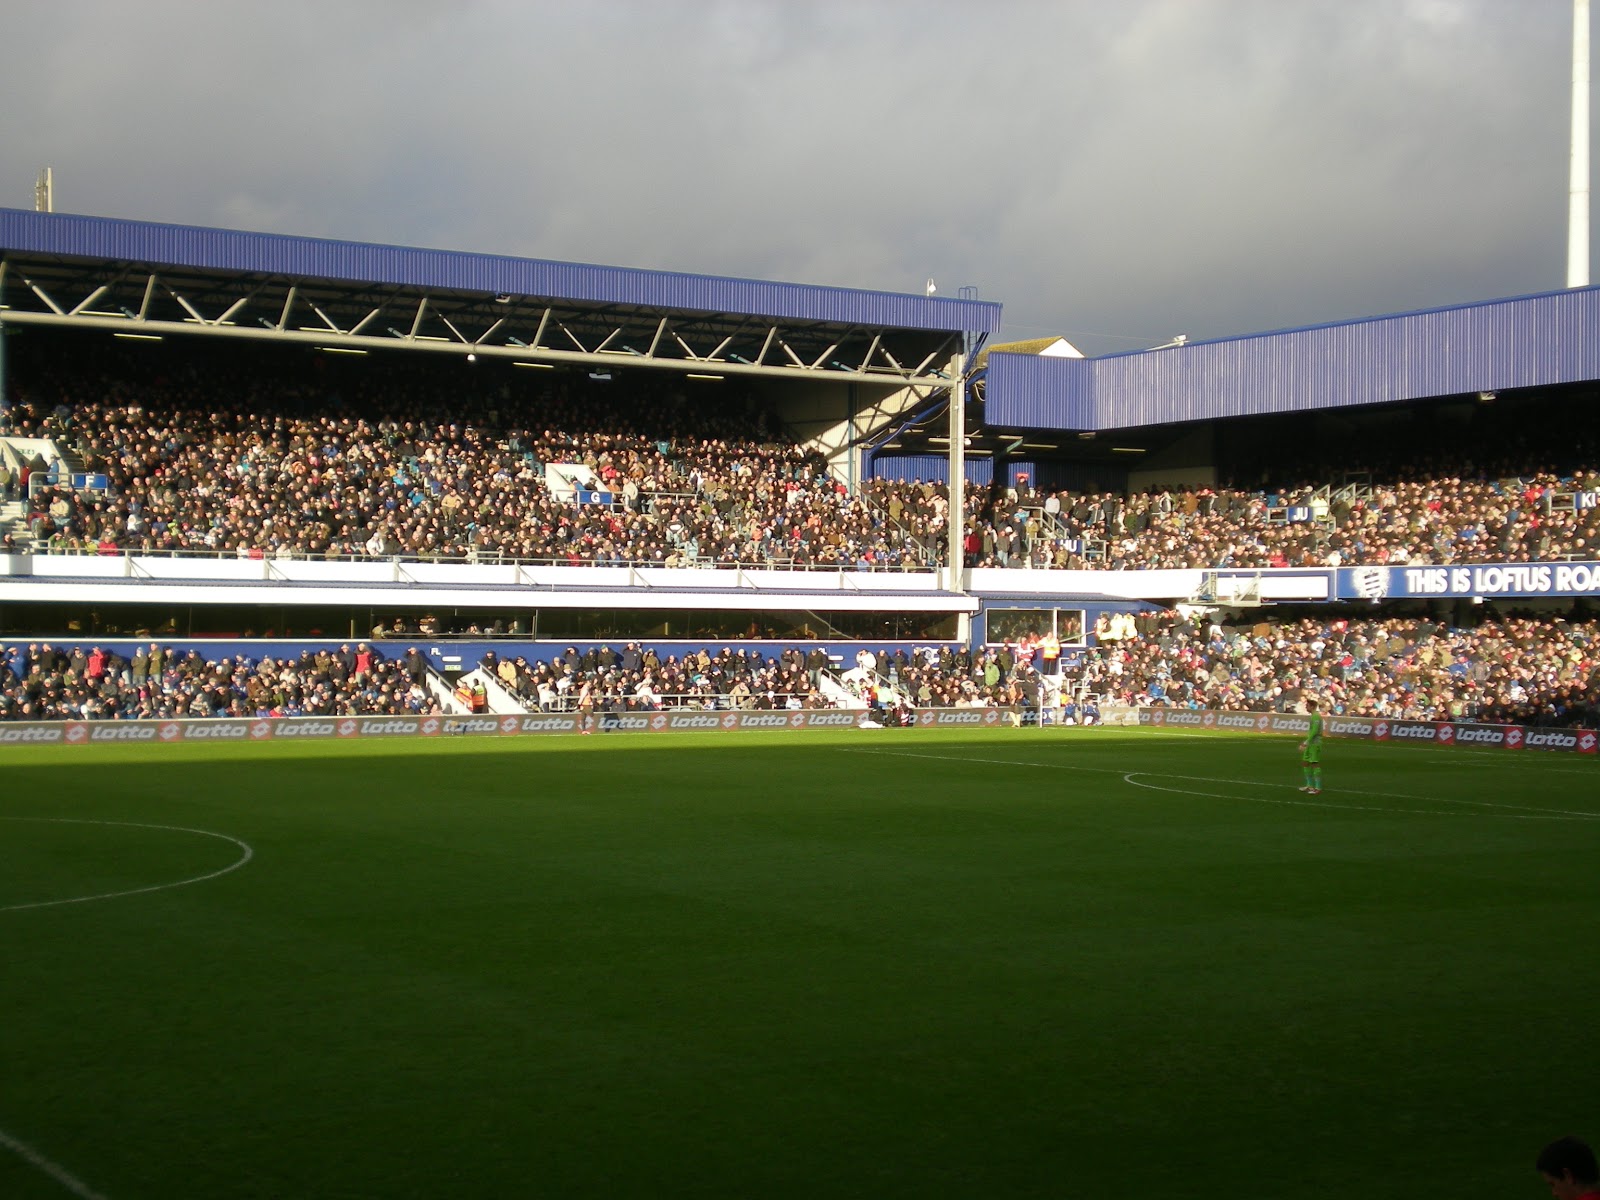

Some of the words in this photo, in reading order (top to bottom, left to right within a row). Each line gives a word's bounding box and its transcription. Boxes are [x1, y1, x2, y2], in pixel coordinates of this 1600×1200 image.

[590, 491, 601, 503] G
[1293, 507, 1308, 520] JU
[1405, 568, 1448, 593] THIS
[1452, 568, 1471, 593] IS
[1475, 566, 1551, 592] LOFTUS
[670, 714, 719, 727] lotto
[740, 714, 787, 726] lotto
[808, 713, 853, 725] lotto
[938, 711, 982, 723] lotto
[1166, 713, 1201, 724] lotto
[1217, 714, 1255, 727] lotto
[1272, 717, 1310, 730] lotto
[185, 724, 247, 737] lotto
[274, 722, 334, 735] lotto
[360, 720, 418, 733] lotto
[522, 718, 574, 730] lotto
[1330, 720, 1372, 735] lotto
[91, 725, 155, 739] lotto
[1391, 724, 1437, 739] lotto
[1456, 728, 1504, 743] lotto
[1525, 731, 1577, 747] lotto
